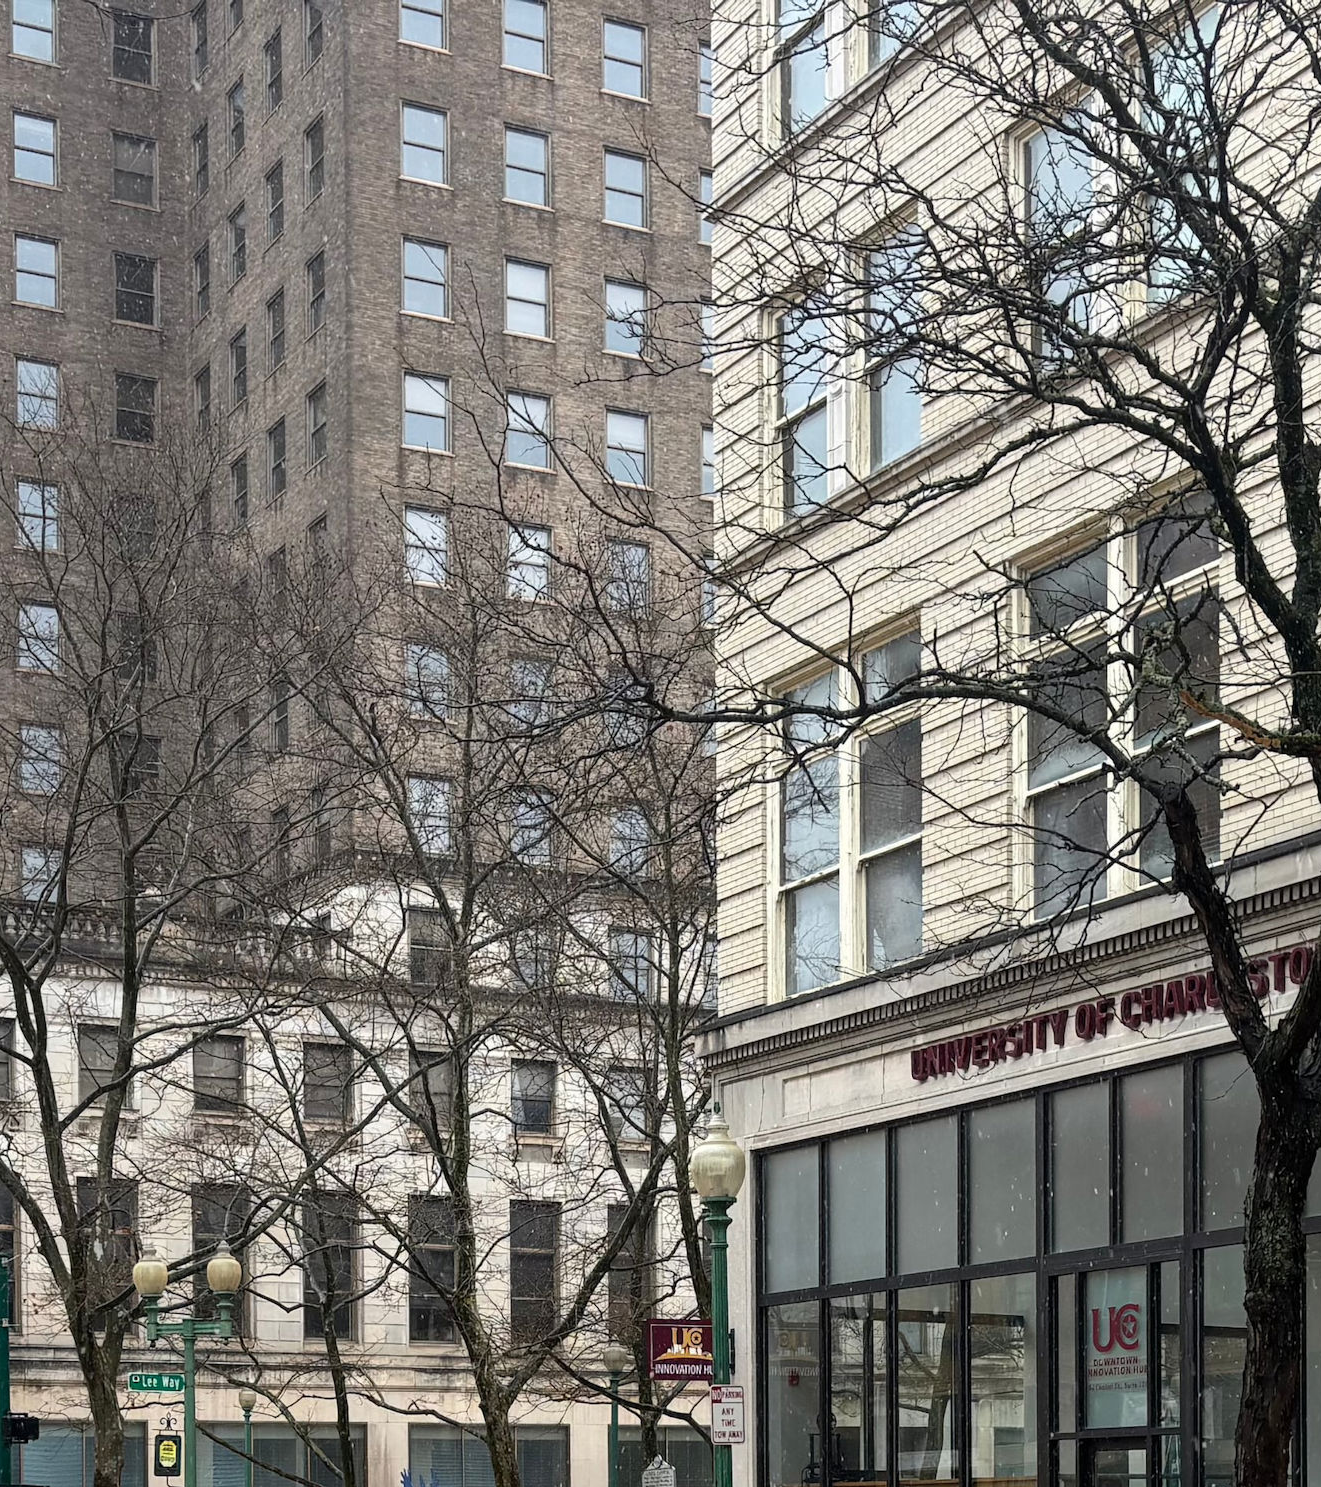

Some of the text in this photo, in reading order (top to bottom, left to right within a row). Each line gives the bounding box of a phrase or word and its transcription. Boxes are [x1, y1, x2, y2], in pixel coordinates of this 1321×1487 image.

[911, 946, 1317, 1082] UNIVERSITY OF CHARLSTO
[1091, 1303, 1140, 1353] UC
[671, 1327, 703, 1349] UC
[1093, 1356, 1138, 1367] DOWNTOWN
[655, 1363, 714, 1375] INNOVATION HU
[142, 1376, 180, 1391] Lee Way
[721, 1407, 734, 1416] ANY
[721, 1418, 736, 1428] TIME
[714, 1430, 727, 1439] TOW
